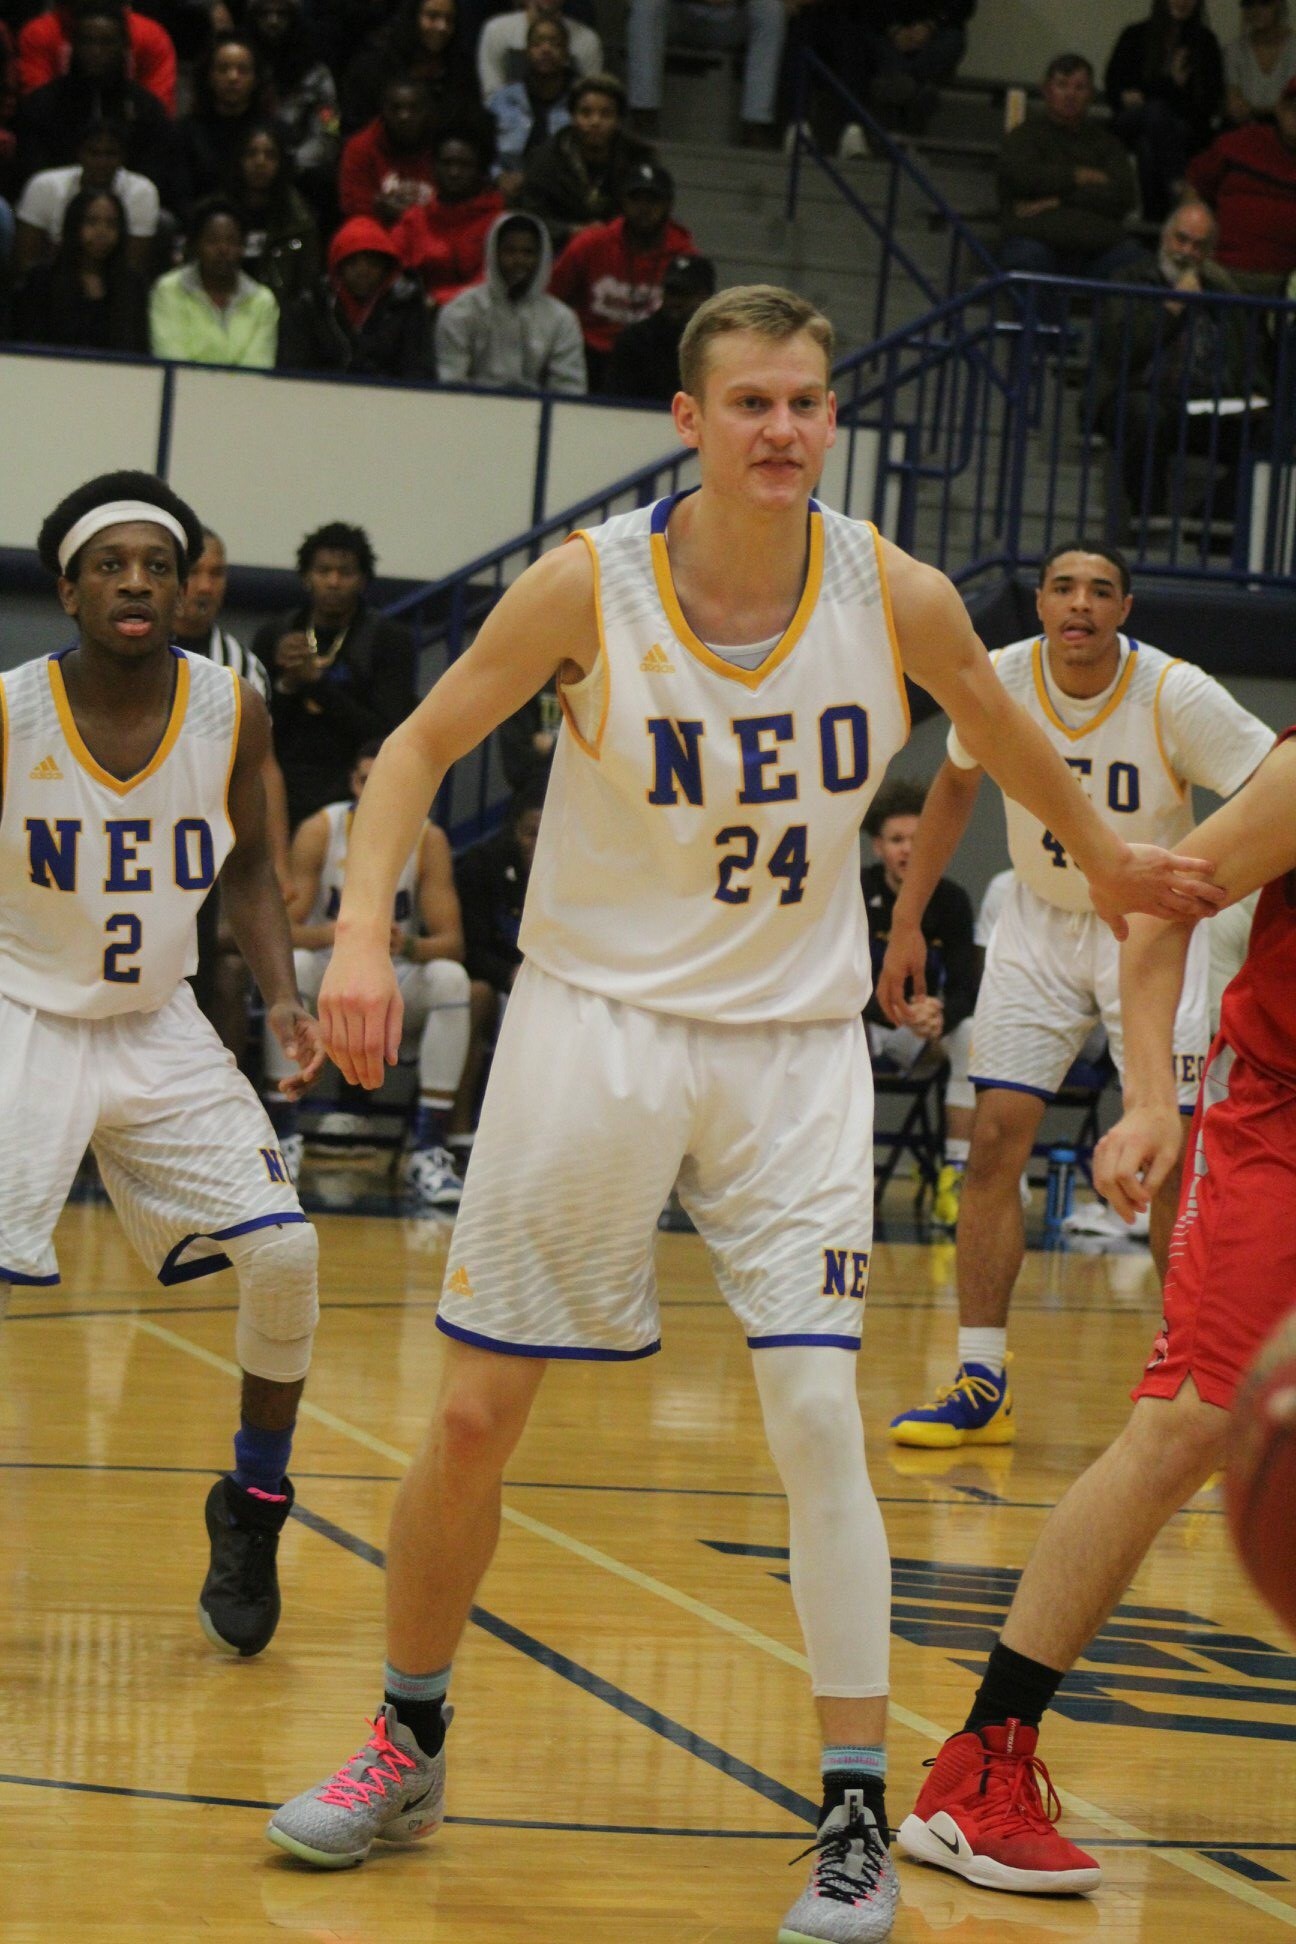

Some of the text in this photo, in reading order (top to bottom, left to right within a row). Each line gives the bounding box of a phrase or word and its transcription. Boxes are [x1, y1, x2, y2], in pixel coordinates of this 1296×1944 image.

[645, 702, 870, 808] NEO
[24, 816, 217, 894] NEO
[712, 822, 811, 907] 24
[103, 912, 143, 985] 2
